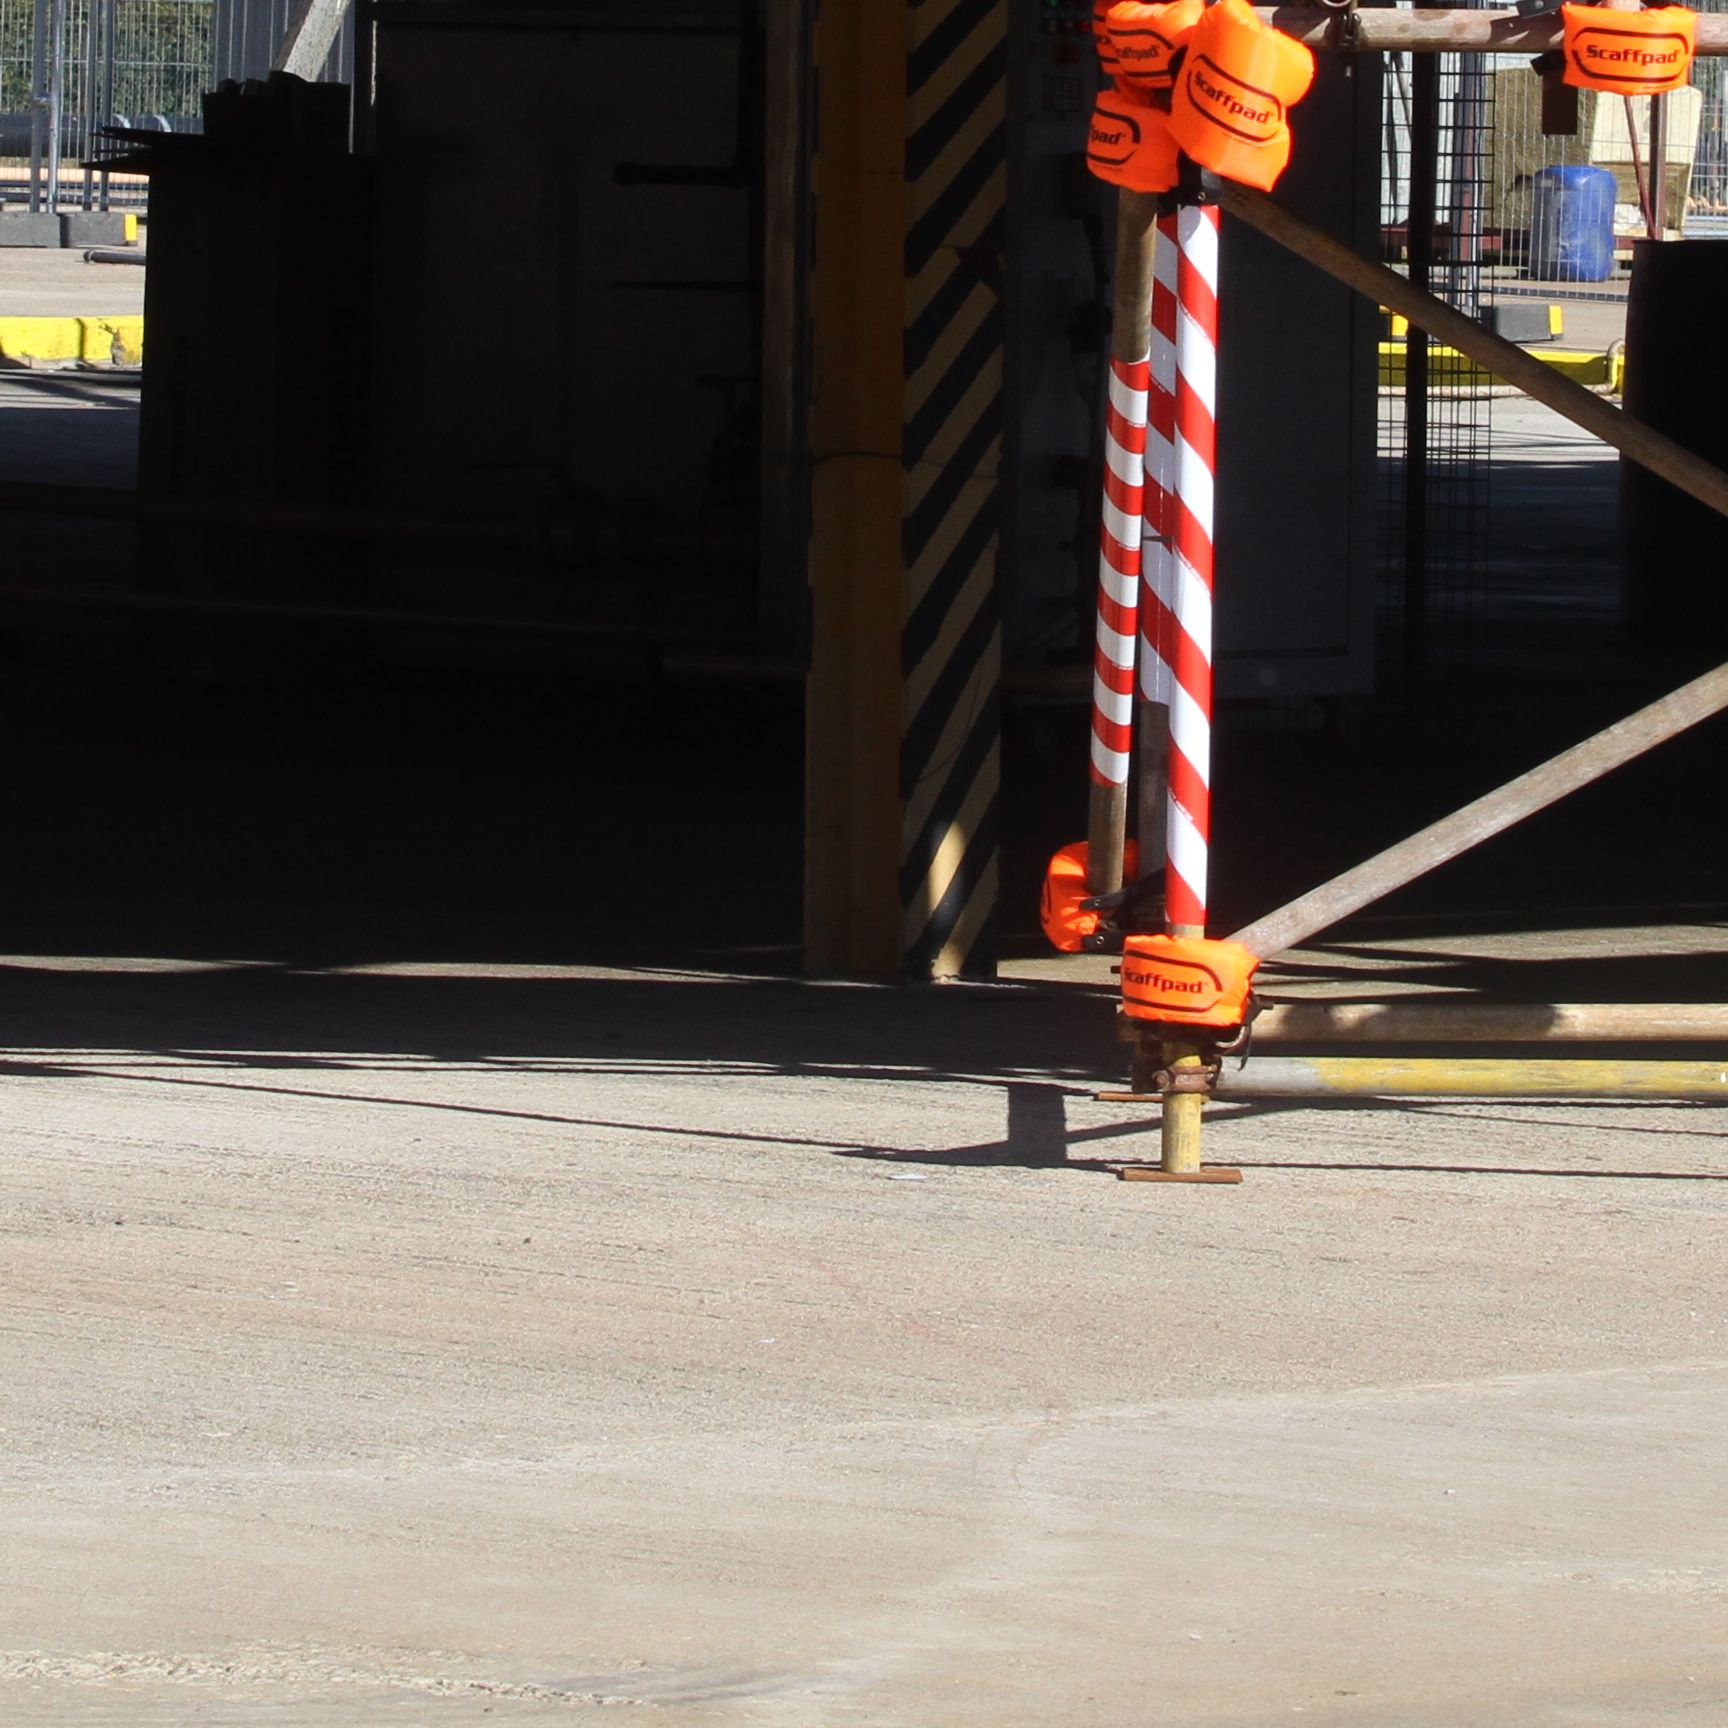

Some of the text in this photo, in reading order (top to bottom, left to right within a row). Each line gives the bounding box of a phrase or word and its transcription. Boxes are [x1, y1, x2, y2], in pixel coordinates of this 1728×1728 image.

[1585, 44, 1678, 66] Scaffpad
[1191, 70, 1275, 126] Scaffpad
[1123, 967, 1203, 995] Scaffpad
